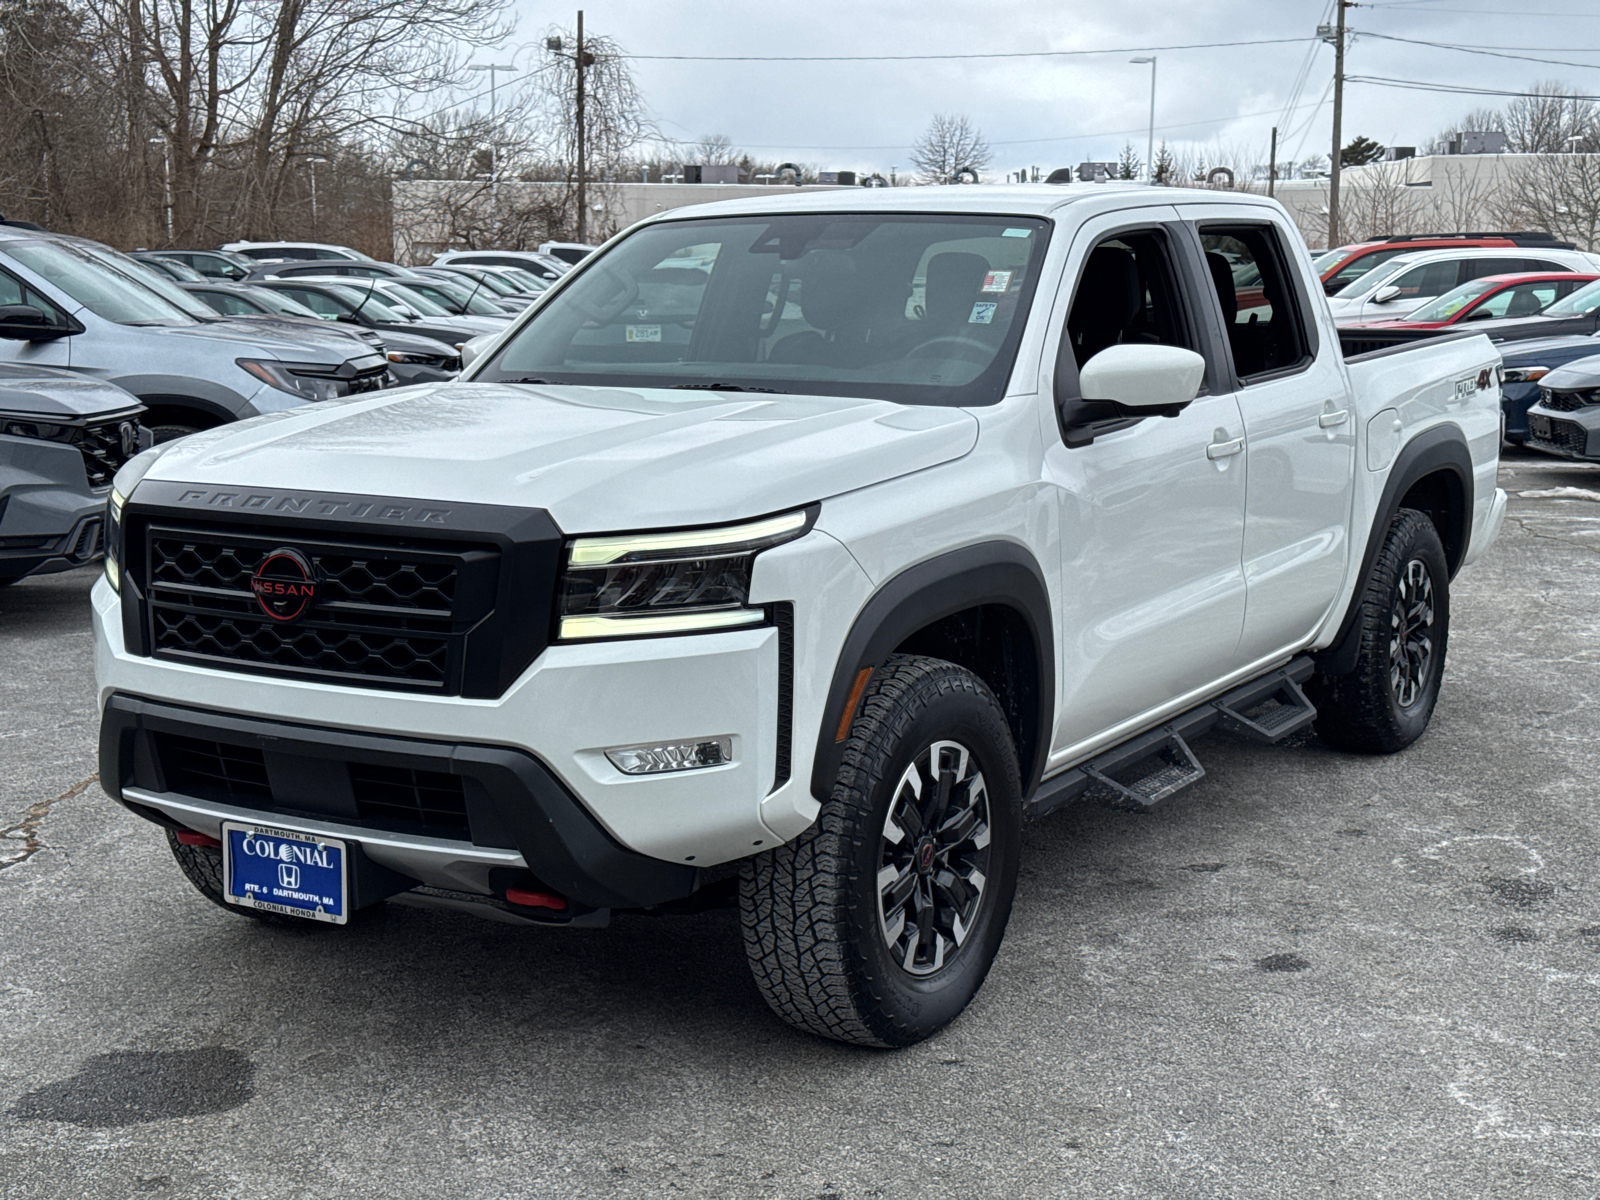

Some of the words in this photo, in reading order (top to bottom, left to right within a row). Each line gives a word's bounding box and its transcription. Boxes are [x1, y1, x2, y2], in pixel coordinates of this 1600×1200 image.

[177, 490, 452, 525] FRONTIER
[250, 579, 315, 597] NISSAN
[304, 835, 317, 843] MA
[242, 837, 334, 869] COLONIAL
[244, 883, 262, 893] RTE.
[262, 886, 268, 894] 6
[273, 887, 321, 905] DARTMOUTH,
[322, 896, 334, 906] MA
[253, 900, 289, 915] COLONIAL
[289, 907, 317, 919] HONDA
